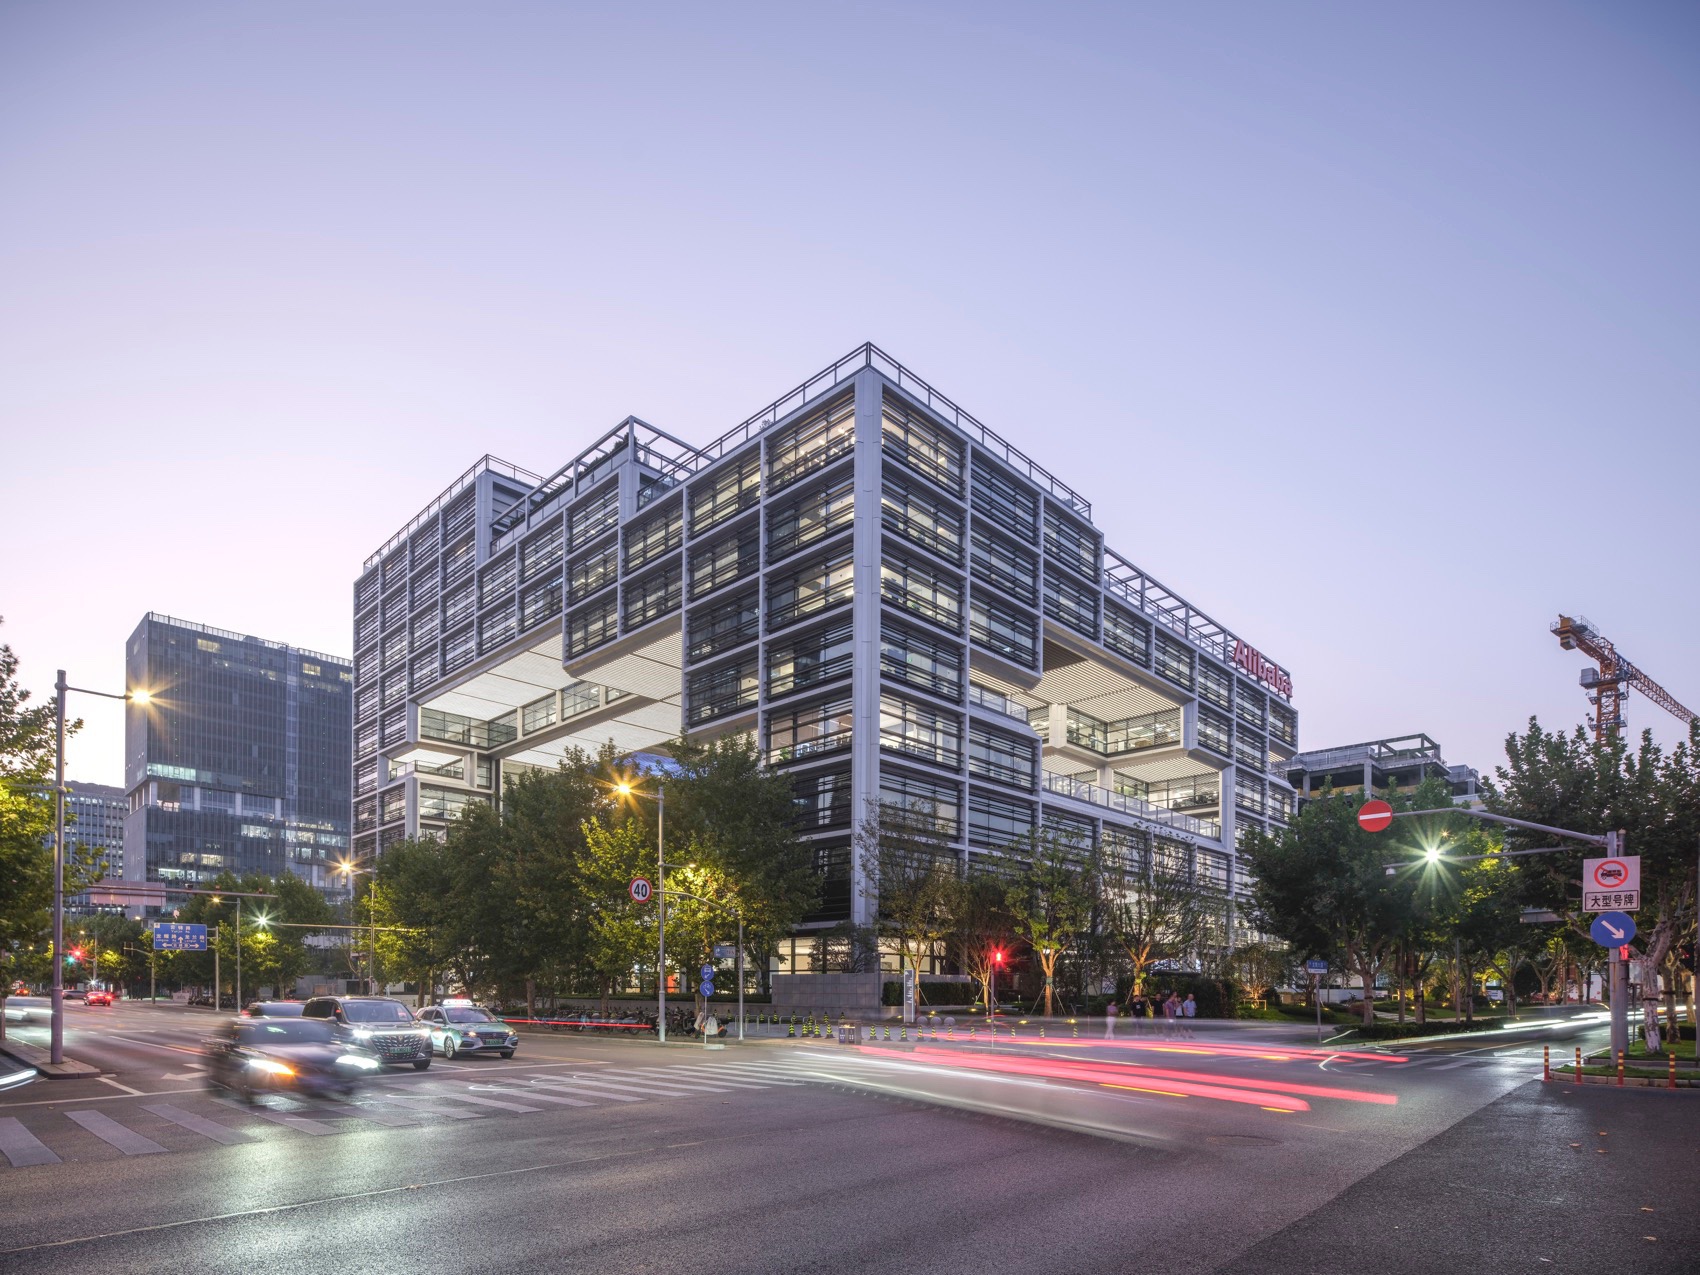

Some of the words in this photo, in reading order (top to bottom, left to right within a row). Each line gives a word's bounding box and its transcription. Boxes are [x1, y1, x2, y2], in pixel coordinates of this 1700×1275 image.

[1233, 639, 1293, 698] Alibaba
[634, 883, 648, 898] 40
[1590, 893, 1635, 908] 大型号牌
